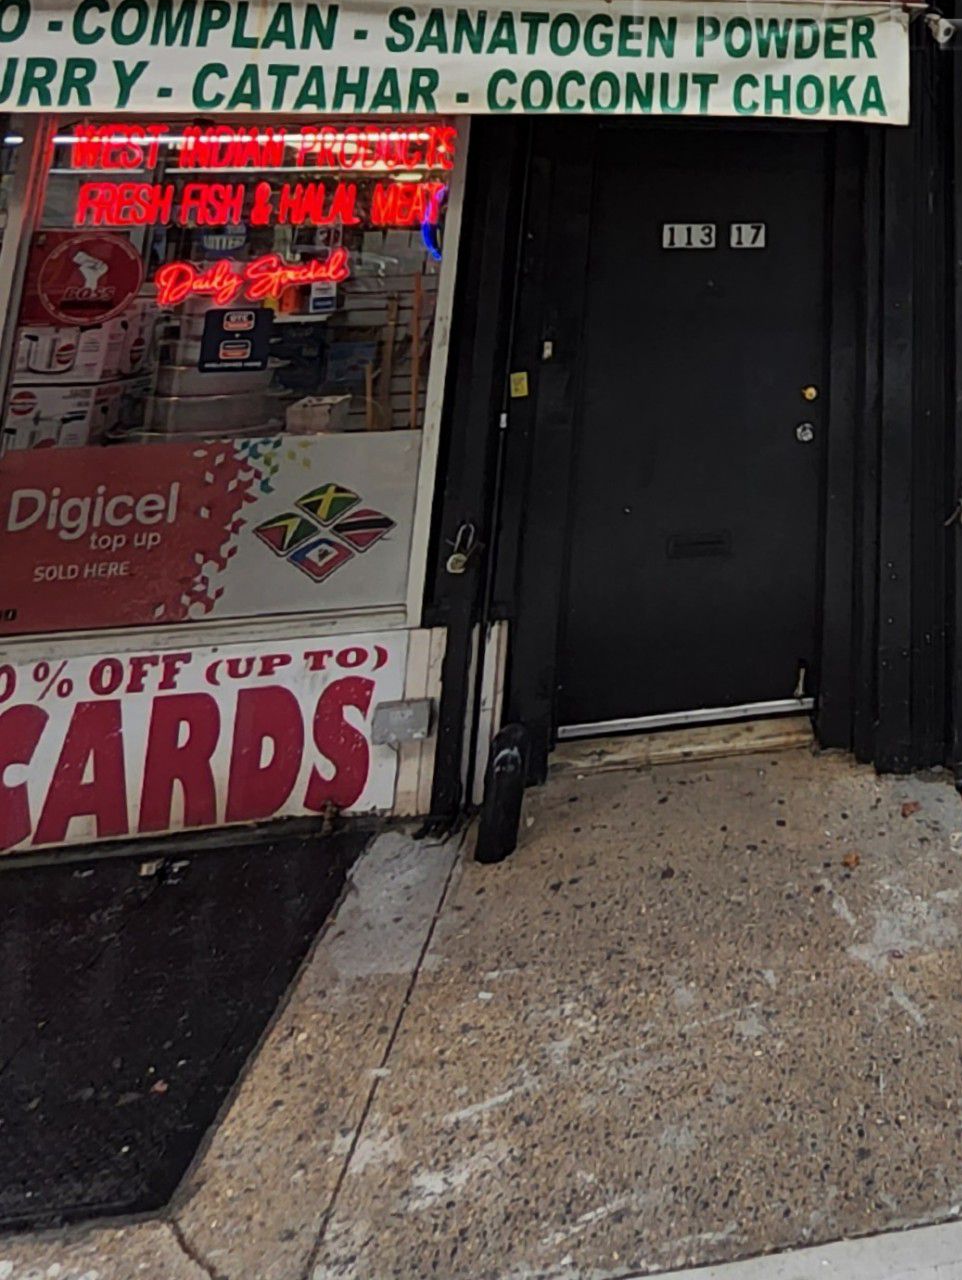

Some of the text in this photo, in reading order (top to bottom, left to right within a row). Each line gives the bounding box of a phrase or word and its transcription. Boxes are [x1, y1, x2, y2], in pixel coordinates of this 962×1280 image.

[385, 6, 678, 58] SANATOGEN
[695, 16, 878, 60] POWDER
[191, 63, 440, 113] CATAHAR
[486, 70, 720, 114] COCONUT
[732, 74, 887, 117] CHOKA
[71, 124, 457, 170] WEST INDIAN PRODUCTS
[75, 181, 446, 226] FRESH FISH & HALAL MEAT
[664, 225, 764, 247] 113 17
[156, 245, 351, 305] Daily Special
[8, 482, 179, 540] Digicel
[90, 531, 161, 551] top up
[33, 561, 130, 582] SOLD HERE
[89, 653, 193, 695] OFF
